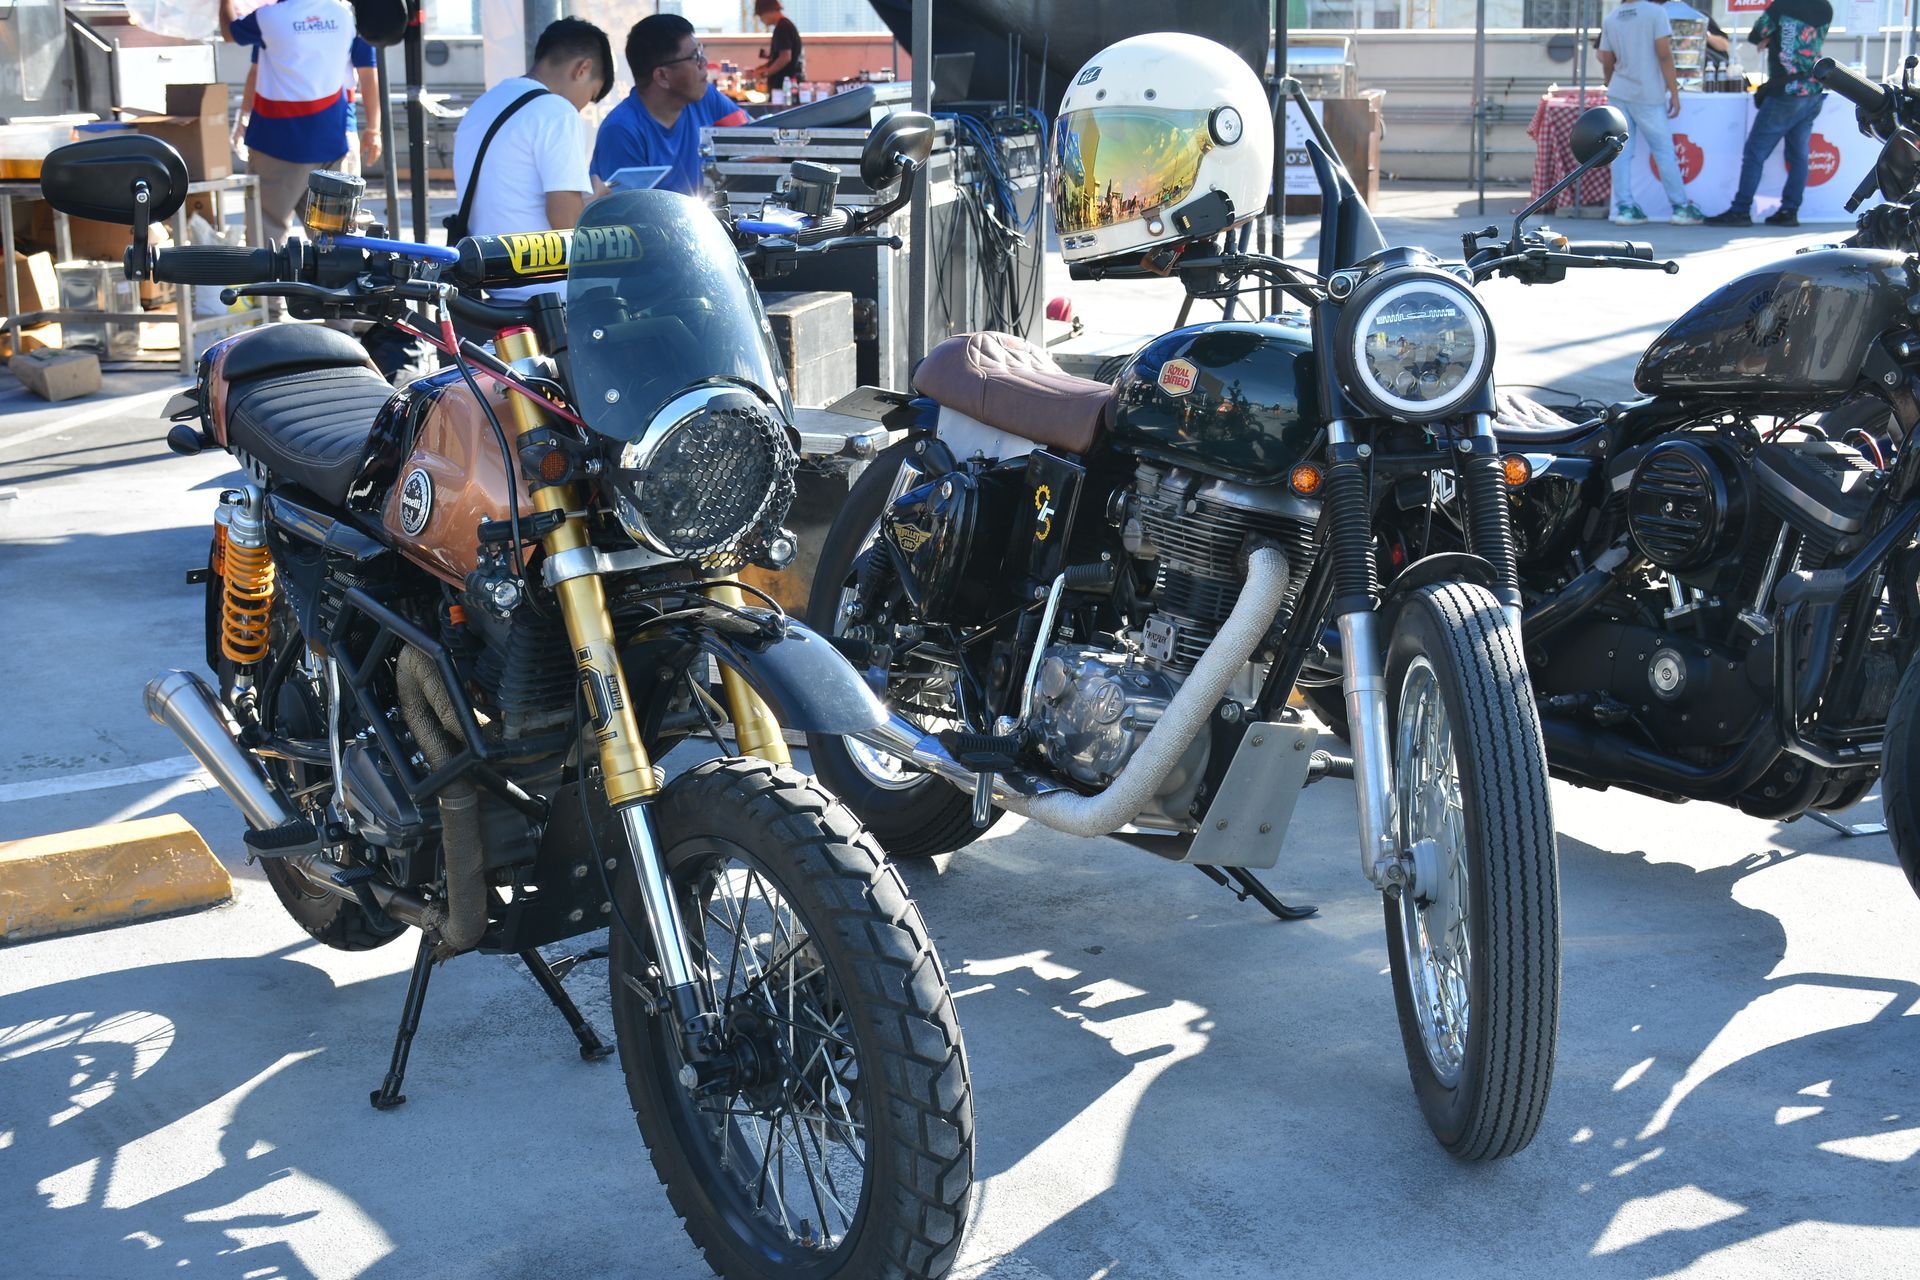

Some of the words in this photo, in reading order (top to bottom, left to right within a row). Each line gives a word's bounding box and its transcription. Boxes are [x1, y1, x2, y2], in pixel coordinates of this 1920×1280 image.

[510, 226, 633, 271] PROTAPER
[1167, 364, 1190, 378] ROYAL
[1162, 374, 1190, 389] ENFIELD
[403, 493, 422, 510] Benelli
